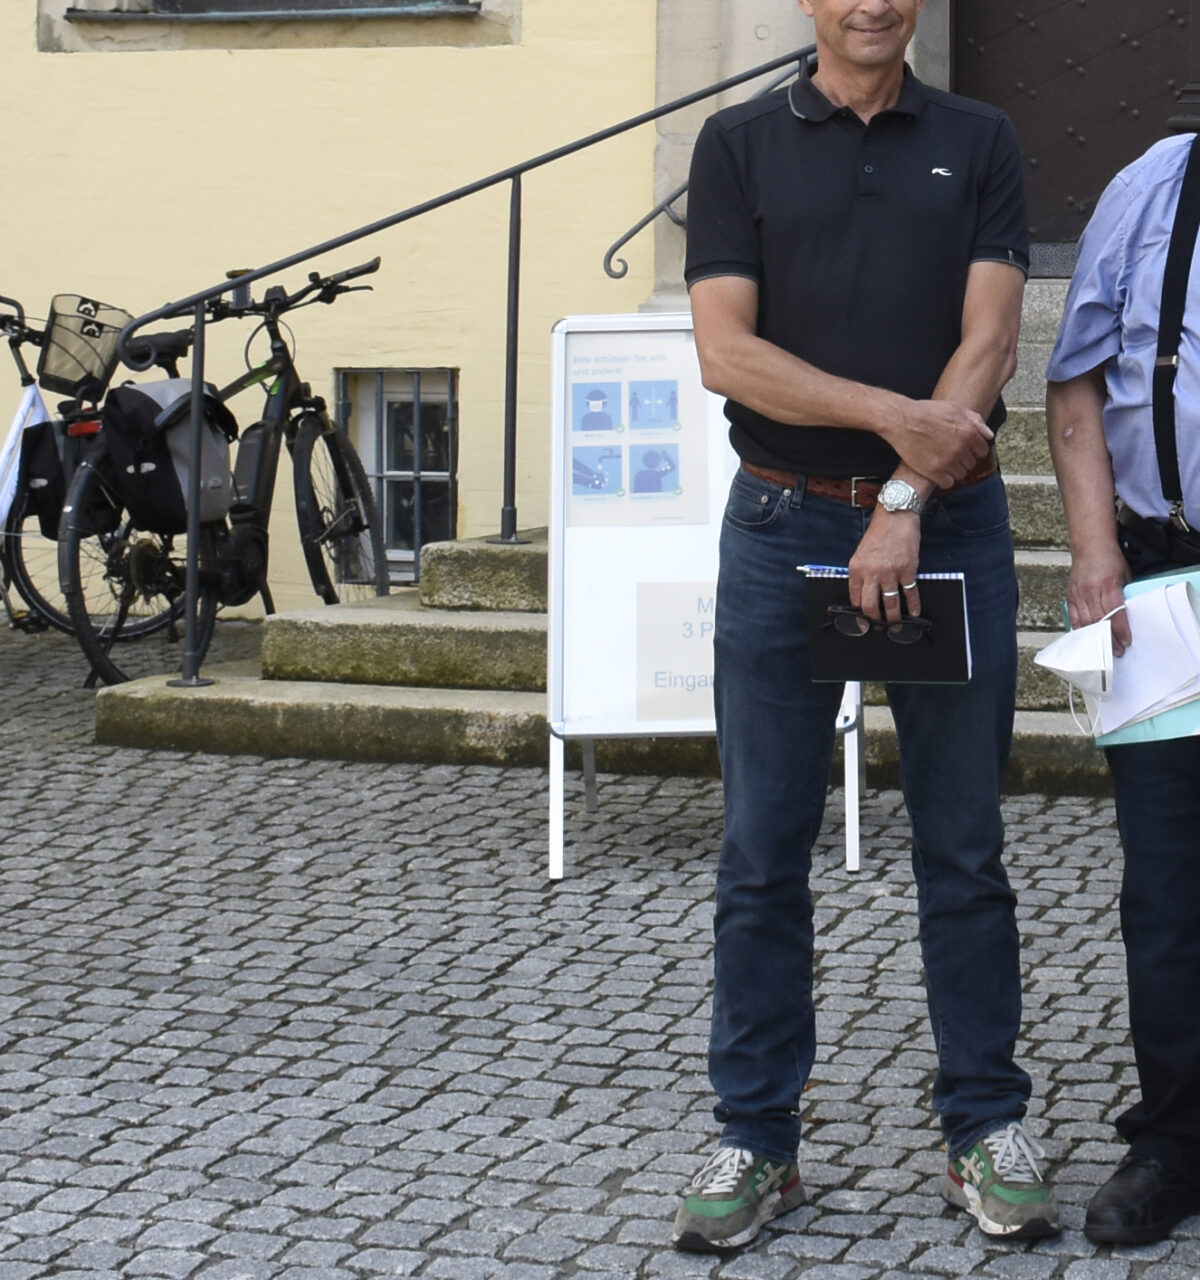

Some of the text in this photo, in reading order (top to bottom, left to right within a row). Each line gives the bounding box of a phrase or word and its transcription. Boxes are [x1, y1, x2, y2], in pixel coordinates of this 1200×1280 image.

[697, 597, 714, 614] M
[682, 621, 714, 639] 3 P
